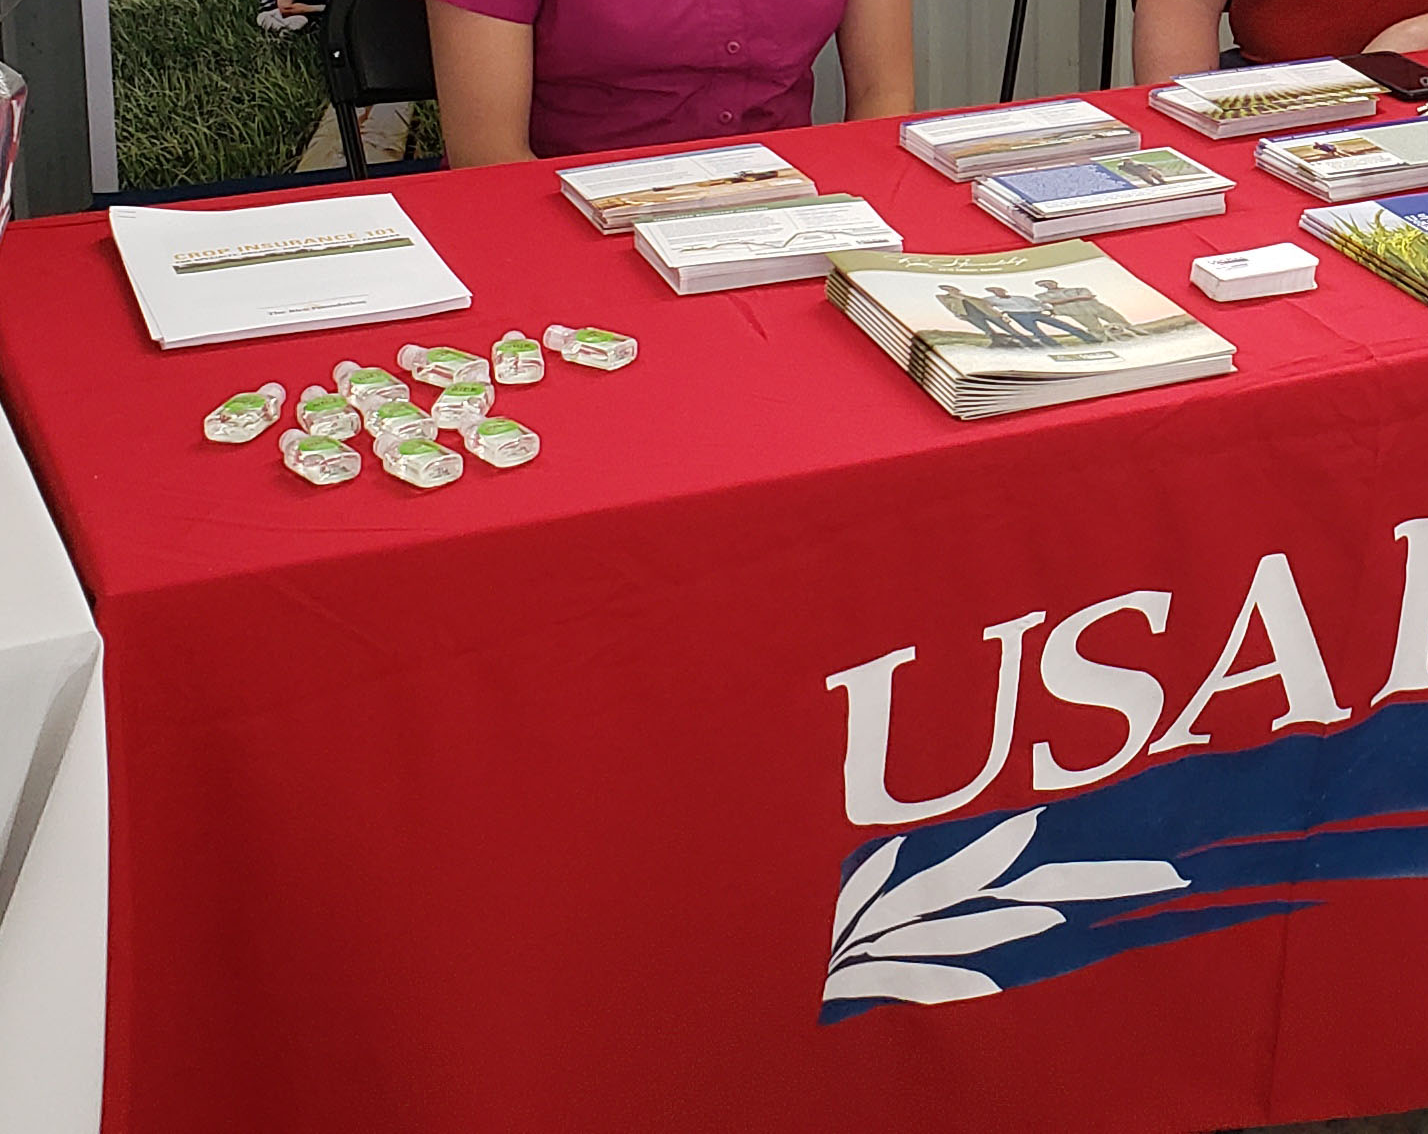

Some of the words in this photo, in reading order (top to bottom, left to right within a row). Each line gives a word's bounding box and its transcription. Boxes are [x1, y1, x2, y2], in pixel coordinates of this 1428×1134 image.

[172, 246, 231, 261] CROP
[237, 232, 357, 253] INSURANCE
[364, 227, 397, 238] 101
[825, 552, 1353, 829] USA
